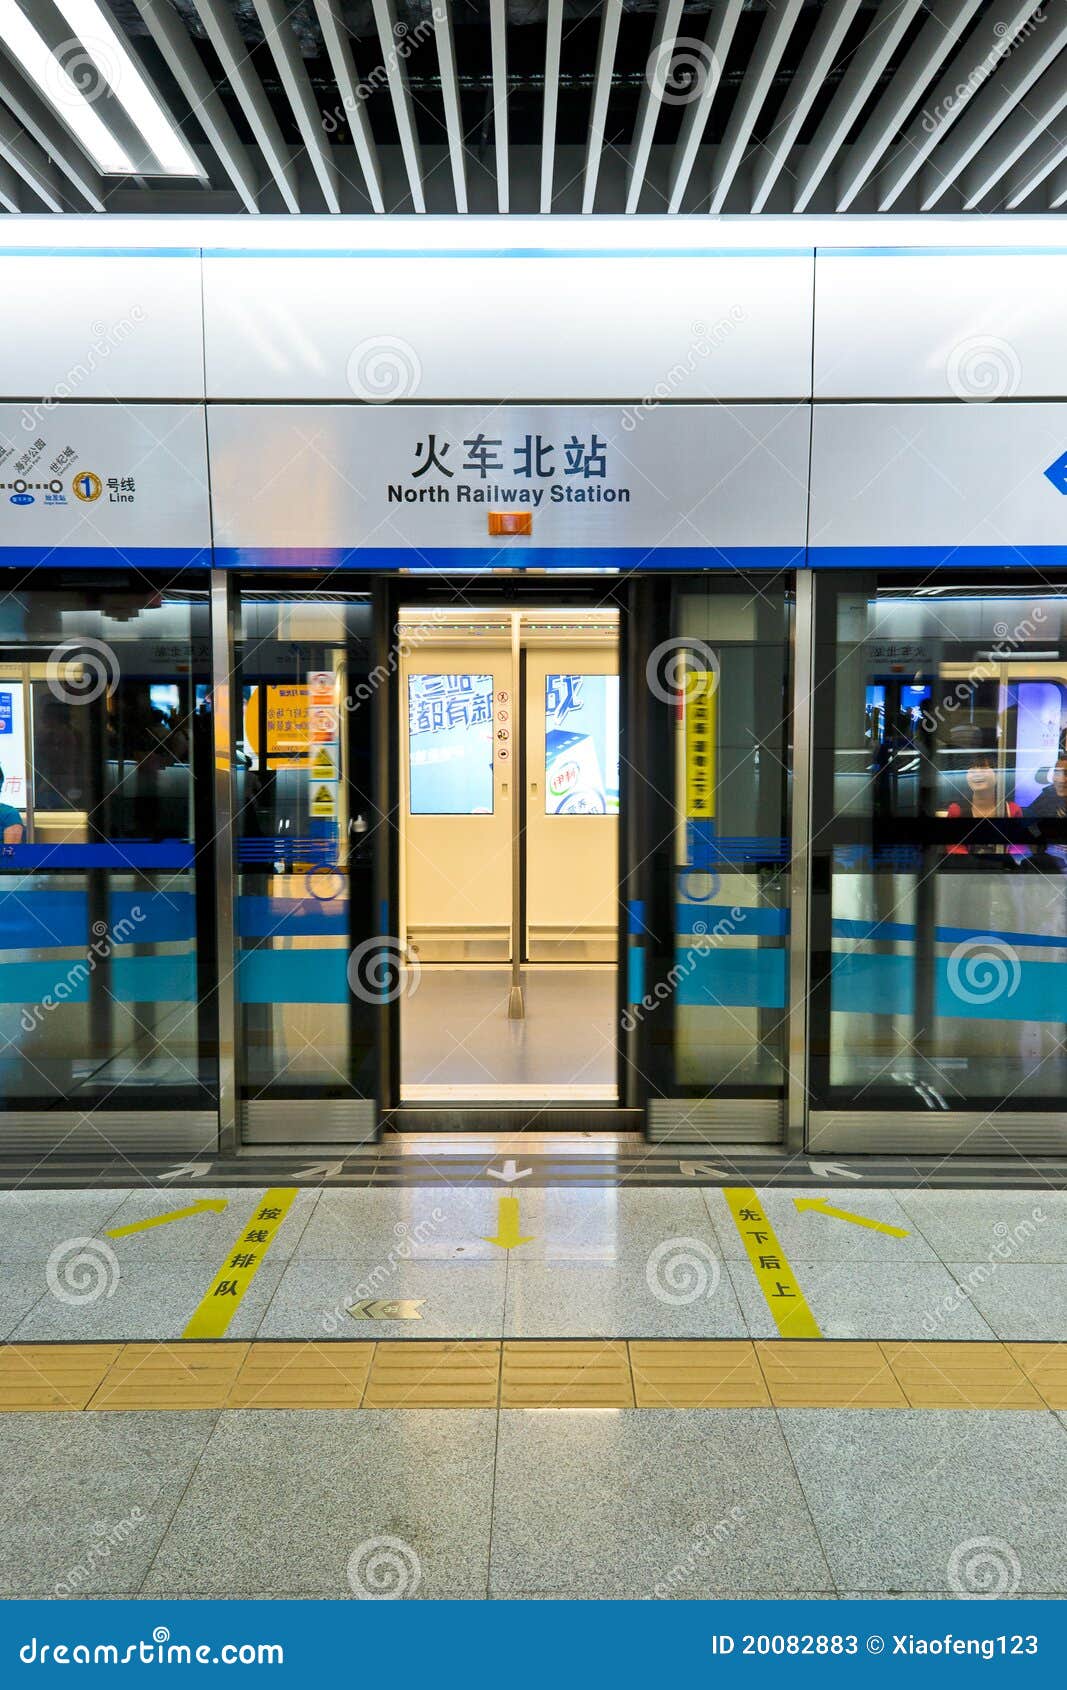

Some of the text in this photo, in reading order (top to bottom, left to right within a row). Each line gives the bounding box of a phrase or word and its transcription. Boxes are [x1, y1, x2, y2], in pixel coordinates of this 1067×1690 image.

[13, 438, 47, 474] 海洋公园
[50, 445, 75, 473] 世纪城
[411, 433, 607, 479] 火车北站
[80, 476, 91, 498] 1
[106, 478, 135, 493] 号线
[109, 493, 134, 502] Line
[387, 484, 630, 507] North Railway Station
[214, 1208, 282, 1296] 按线排队
[739, 1208, 796, 1297] 先下后上
